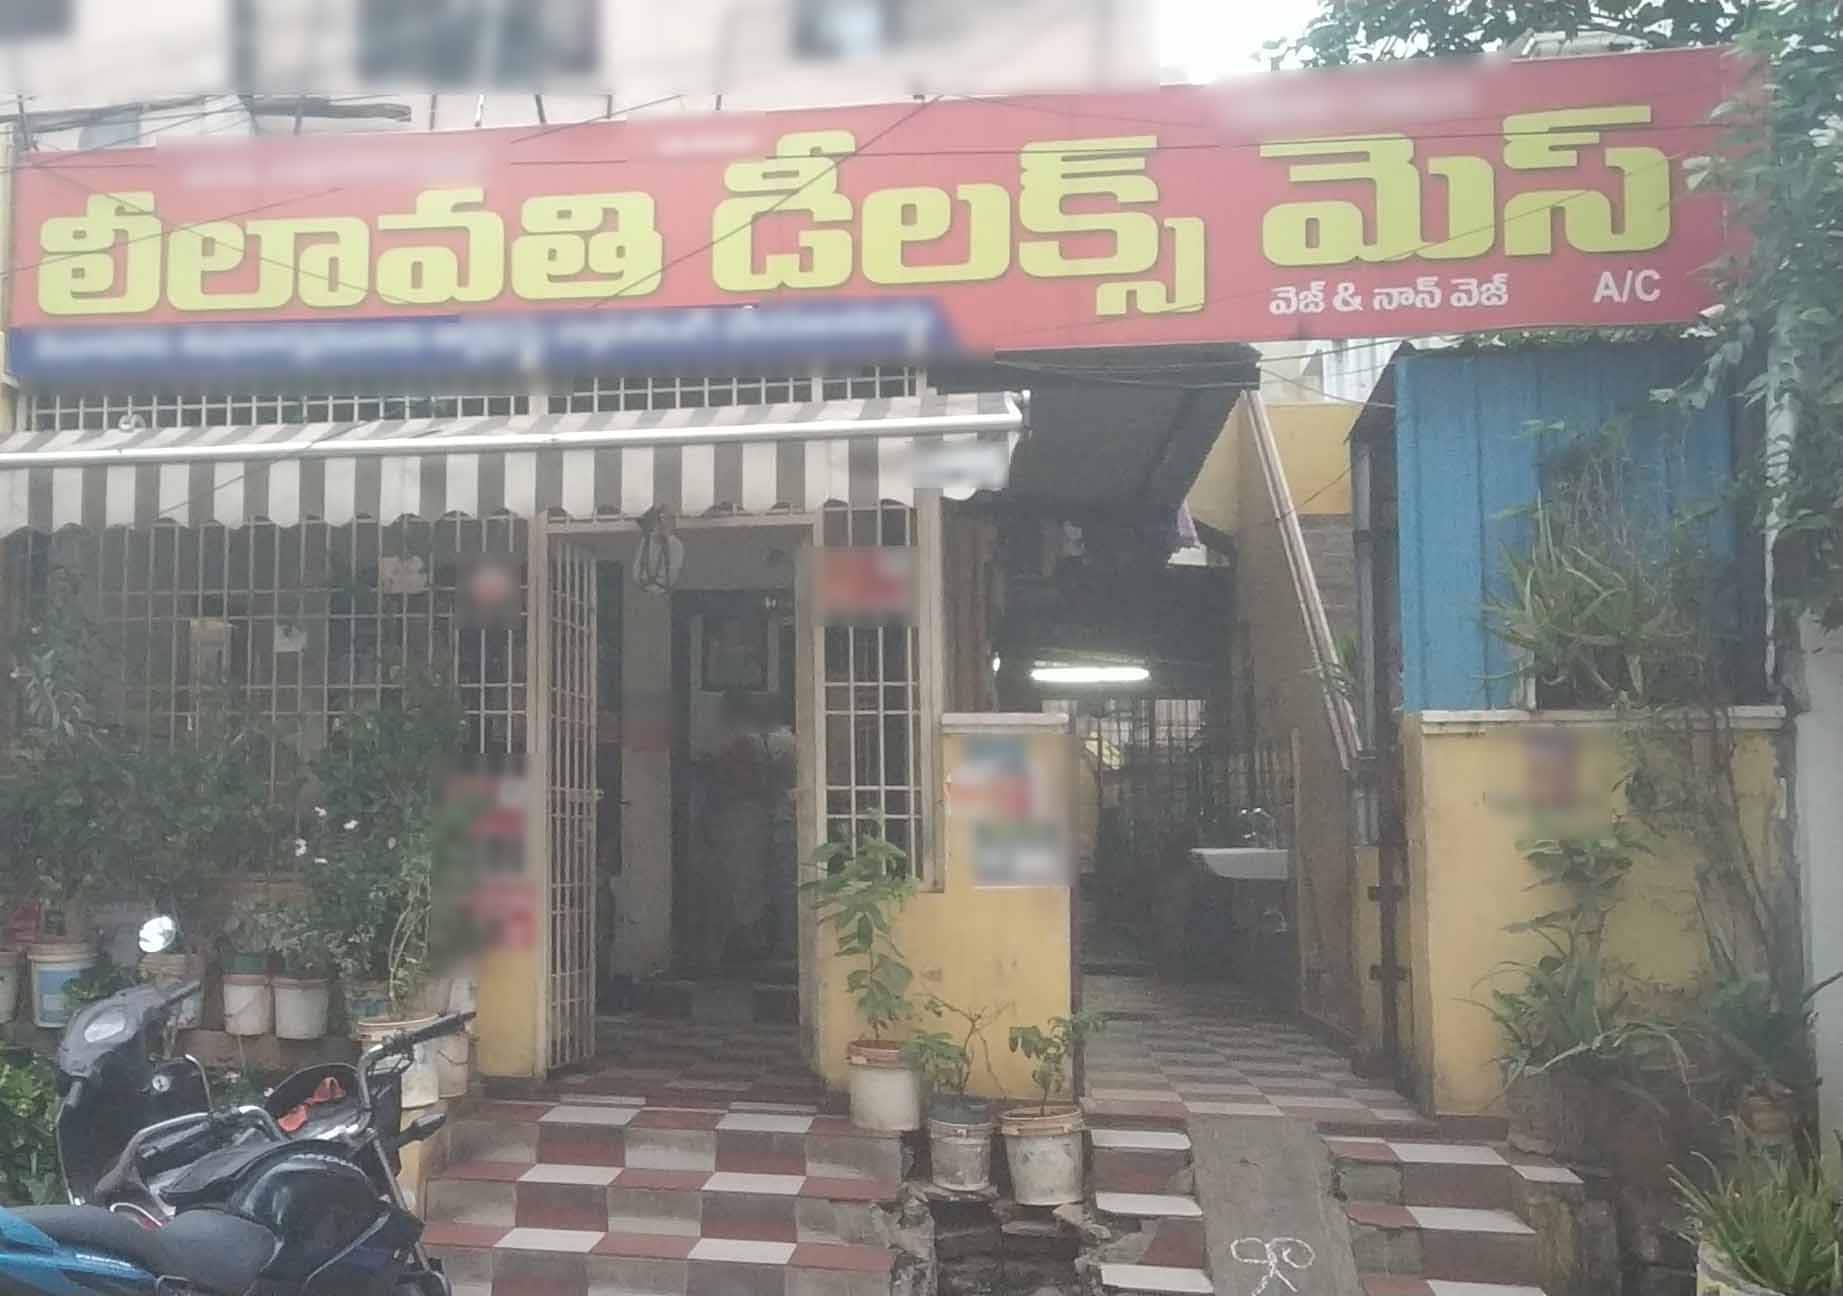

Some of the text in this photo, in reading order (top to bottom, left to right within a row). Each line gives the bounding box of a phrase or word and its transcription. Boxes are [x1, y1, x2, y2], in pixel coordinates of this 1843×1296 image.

[38, 106, 1670, 316] లీలావతి డీలక్స్ మెస్
[1269, 272, 1509, 315] వెజ్ & నాన్ వెజ్
[1592, 269, 1661, 303] A/C
